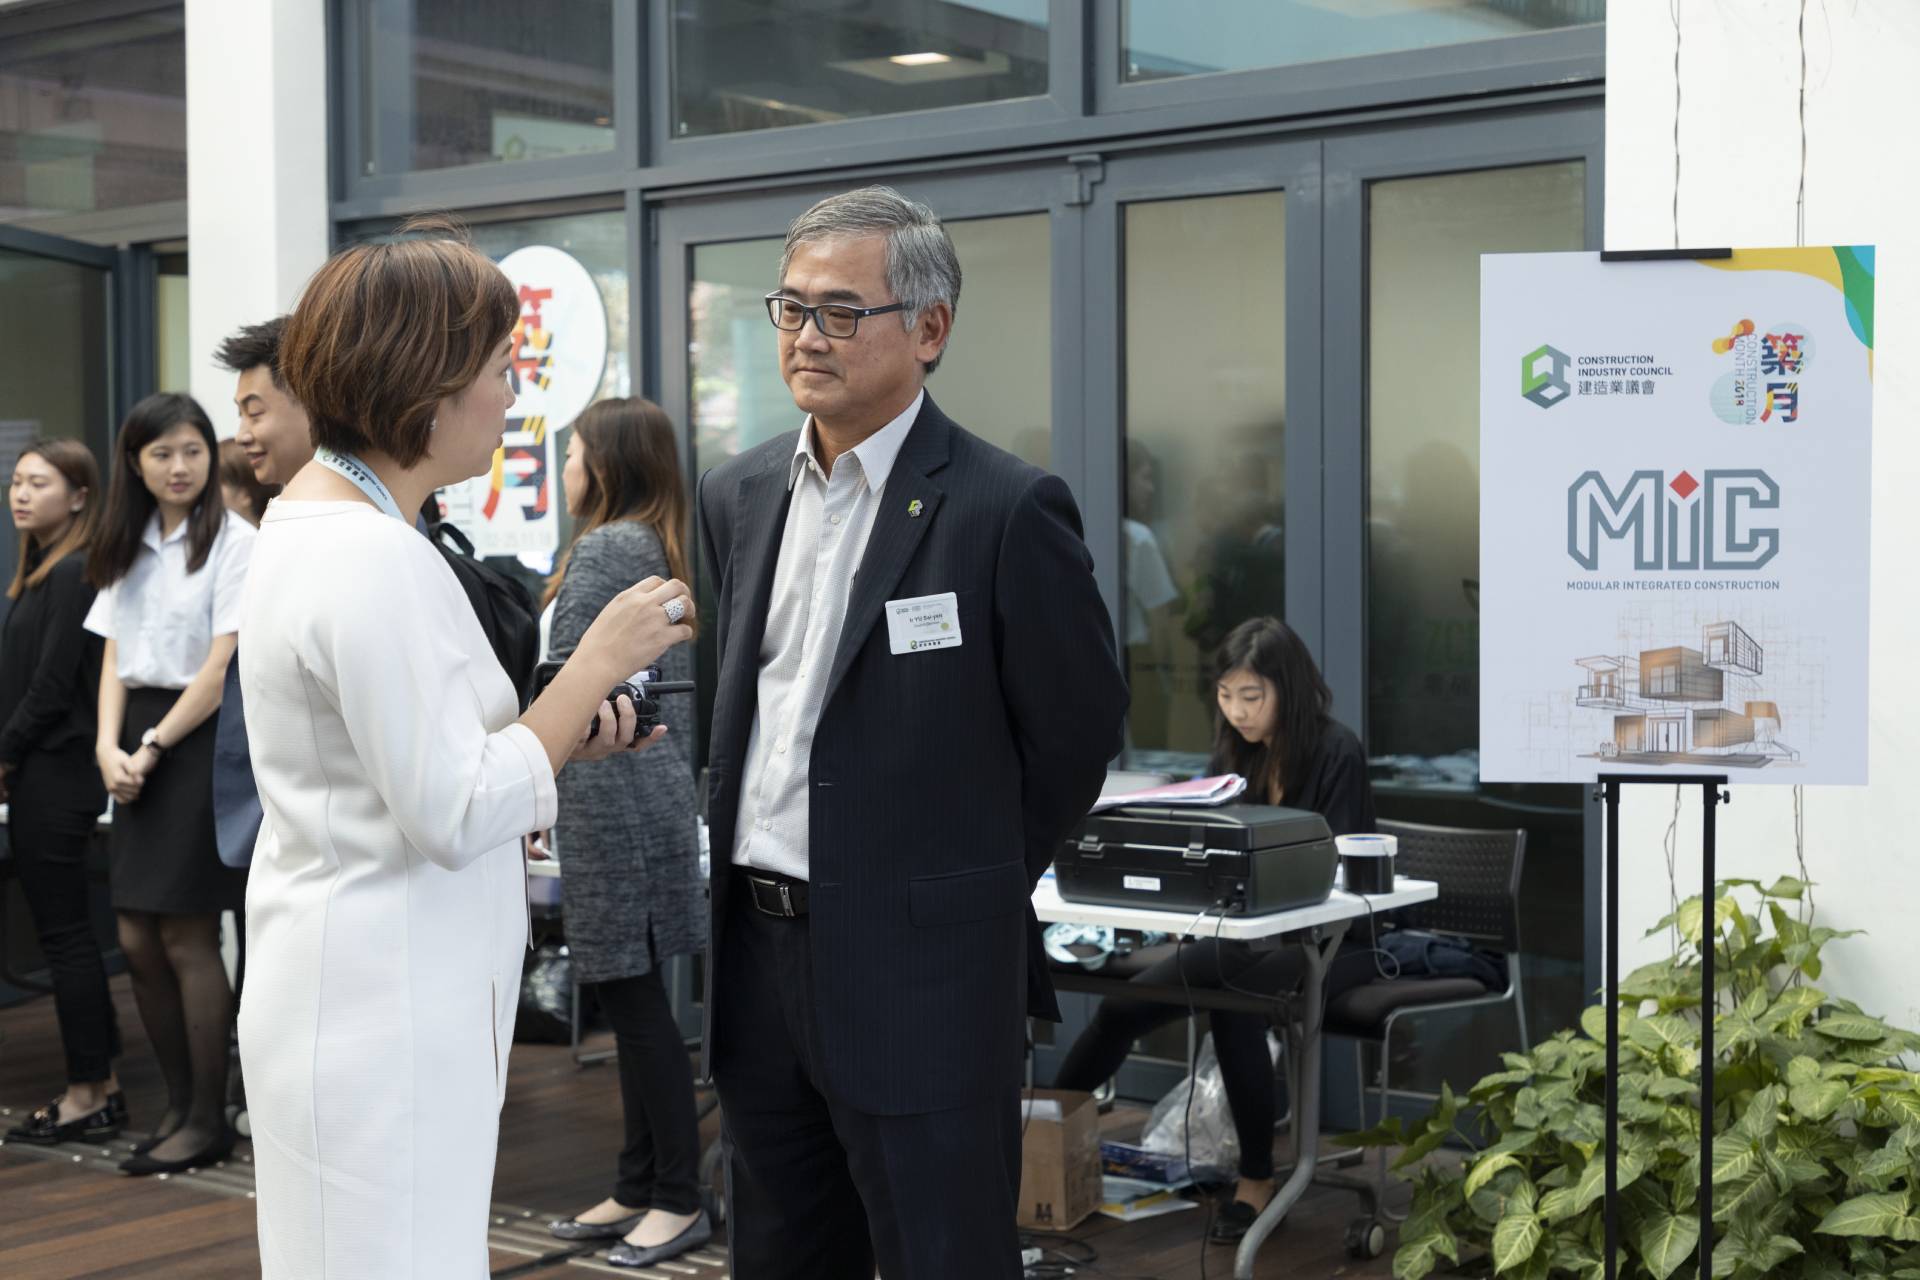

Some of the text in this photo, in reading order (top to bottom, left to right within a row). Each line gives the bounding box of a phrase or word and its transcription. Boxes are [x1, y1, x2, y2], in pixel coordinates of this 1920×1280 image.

[1577, 355, 1654, 365] CONSTRUCTION
[1578, 366, 1673, 377] INDUSTRY COUNCIL
[1745, 333, 1758, 425] CONSTRUCTION
[1577, 380, 1655, 396] 建造業議會
[1735, 380, 1745, 406] 2018
[1566, 580, 1780, 591] MODULAR INTEGRATED CONSTRUCTION
